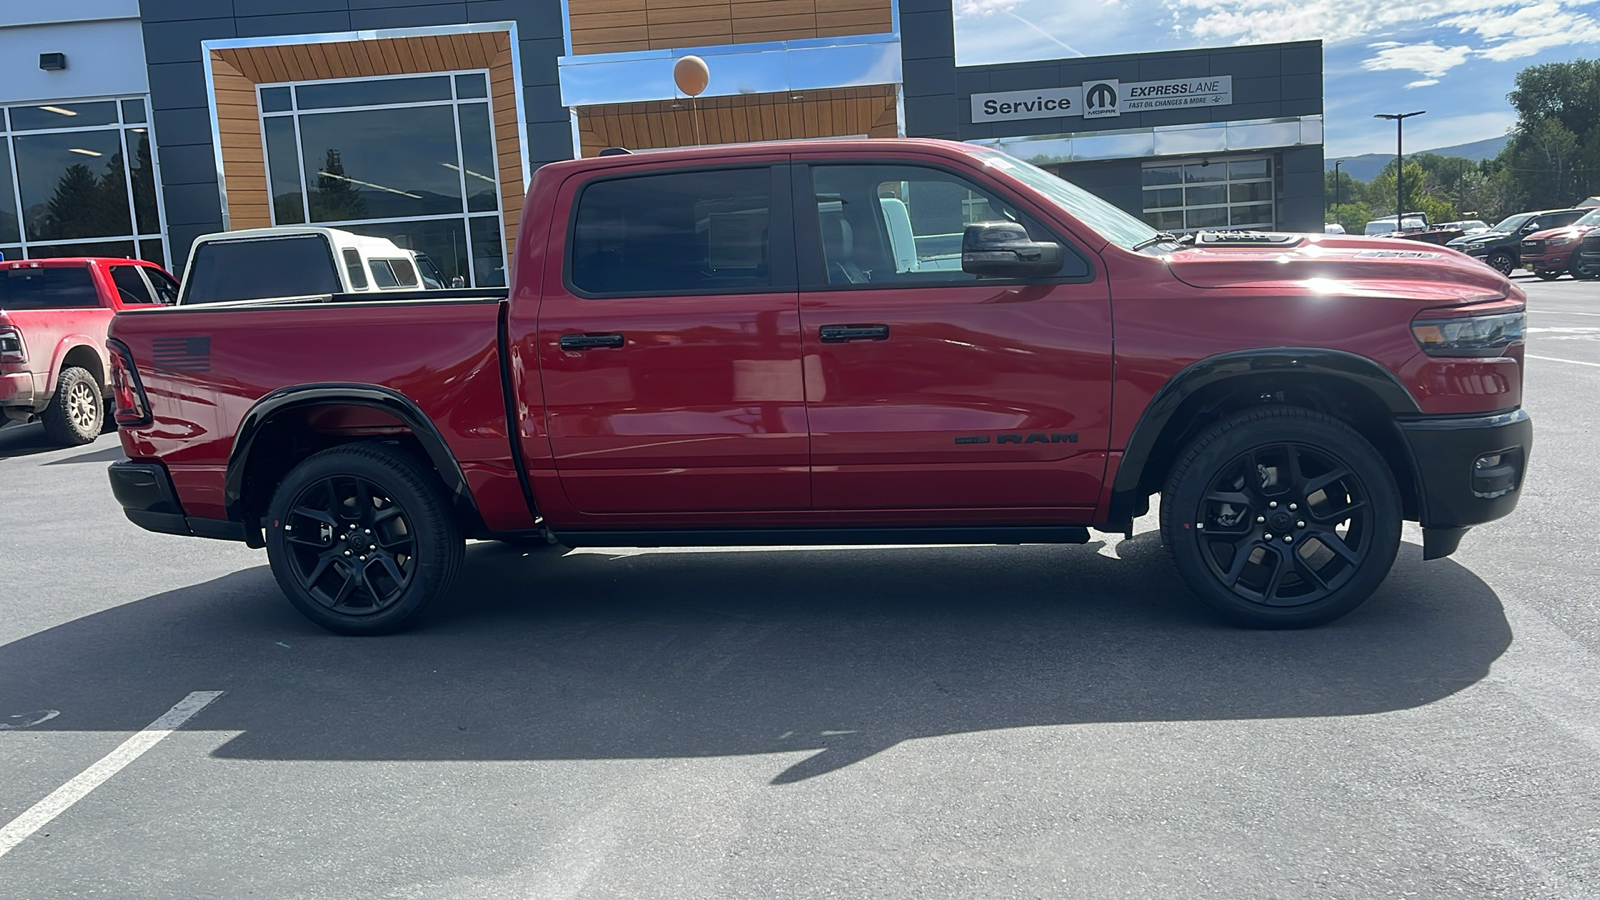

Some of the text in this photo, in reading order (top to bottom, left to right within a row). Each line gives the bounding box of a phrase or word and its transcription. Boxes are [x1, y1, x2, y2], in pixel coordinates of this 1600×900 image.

[1130, 81, 1219, 97] EXPRESSLANE
[984, 97, 1071, 115] Service
[1128, 101, 1144, 109] FAST
[1155, 99, 1183, 107] CHANGES
[997, 432, 1078, 444] RAM
